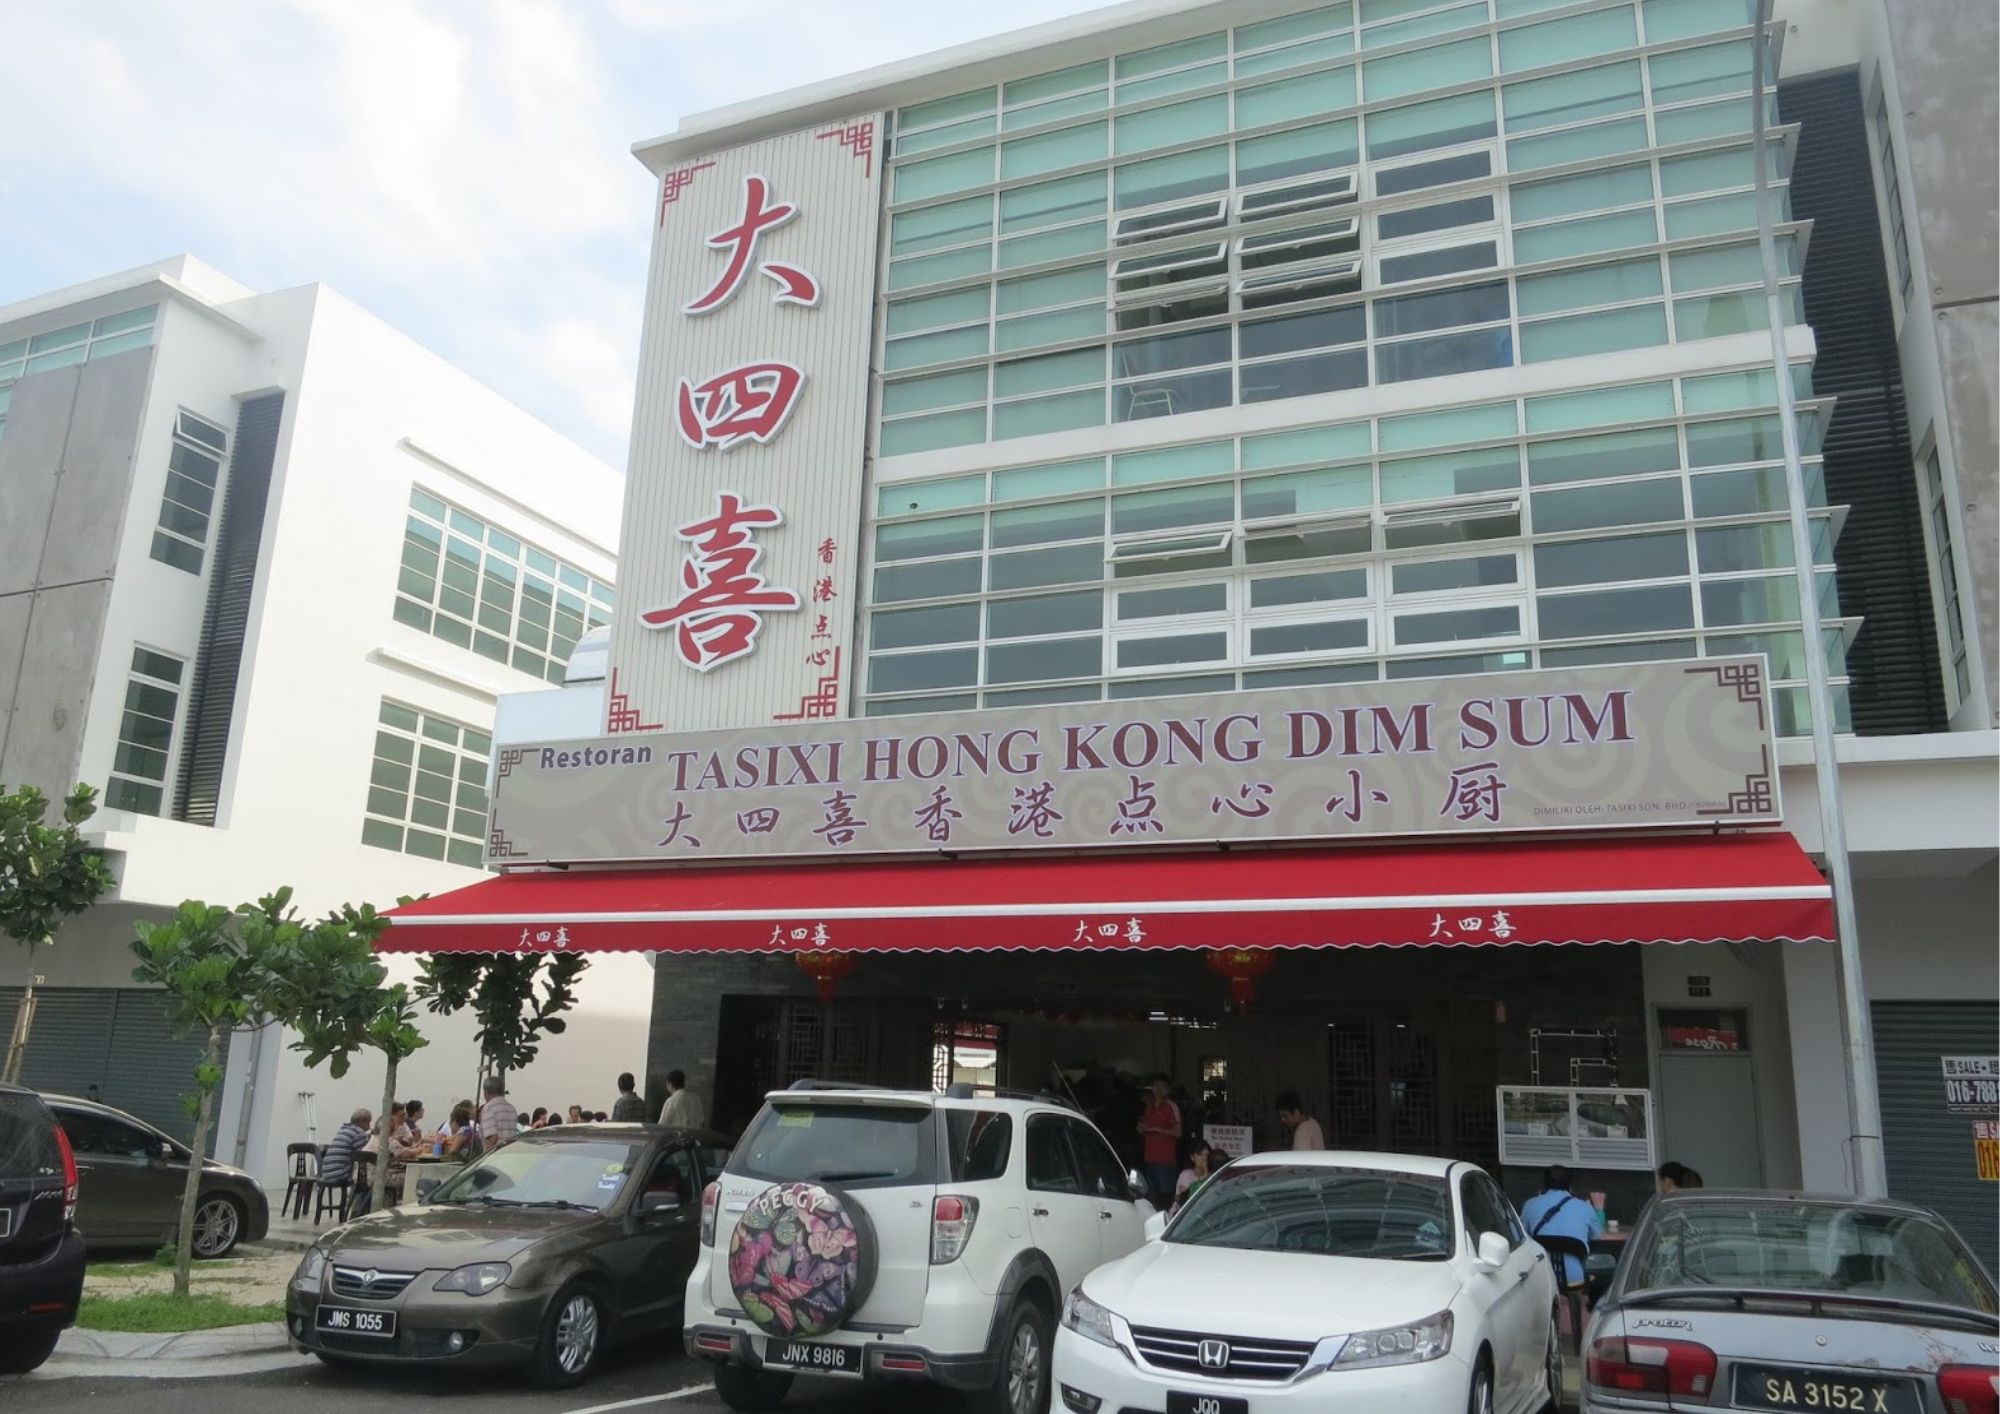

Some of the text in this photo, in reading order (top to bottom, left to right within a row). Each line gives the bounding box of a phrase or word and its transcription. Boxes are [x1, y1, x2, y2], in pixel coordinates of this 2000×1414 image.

[640, 174, 820, 670] 大四喜
[805, 537, 838, 667] 香港点心
[540, 690, 1636, 792] Restoran TASIXI HONG KONG DIM SUM
[1533, 806, 1573, 816] DIMILIKI
[518, 926, 570, 947] 大四喜
[769, 922, 830, 946] 大四喜
[1073, 917, 1147, 943] 大四喜
[1429, 910, 1517, 938] 大四喜
[1957, 1060, 1981, 1074] SALE
[1946, 1080, 1999, 1104] 016-788
[758, 1190, 826, 1216] PEGGY
[327, 1310, 383, 1331] JMS 1055
[782, 1343, 846, 1366] JNX 9816
[1765, 1377, 1889, 1414] SA 3152 X
